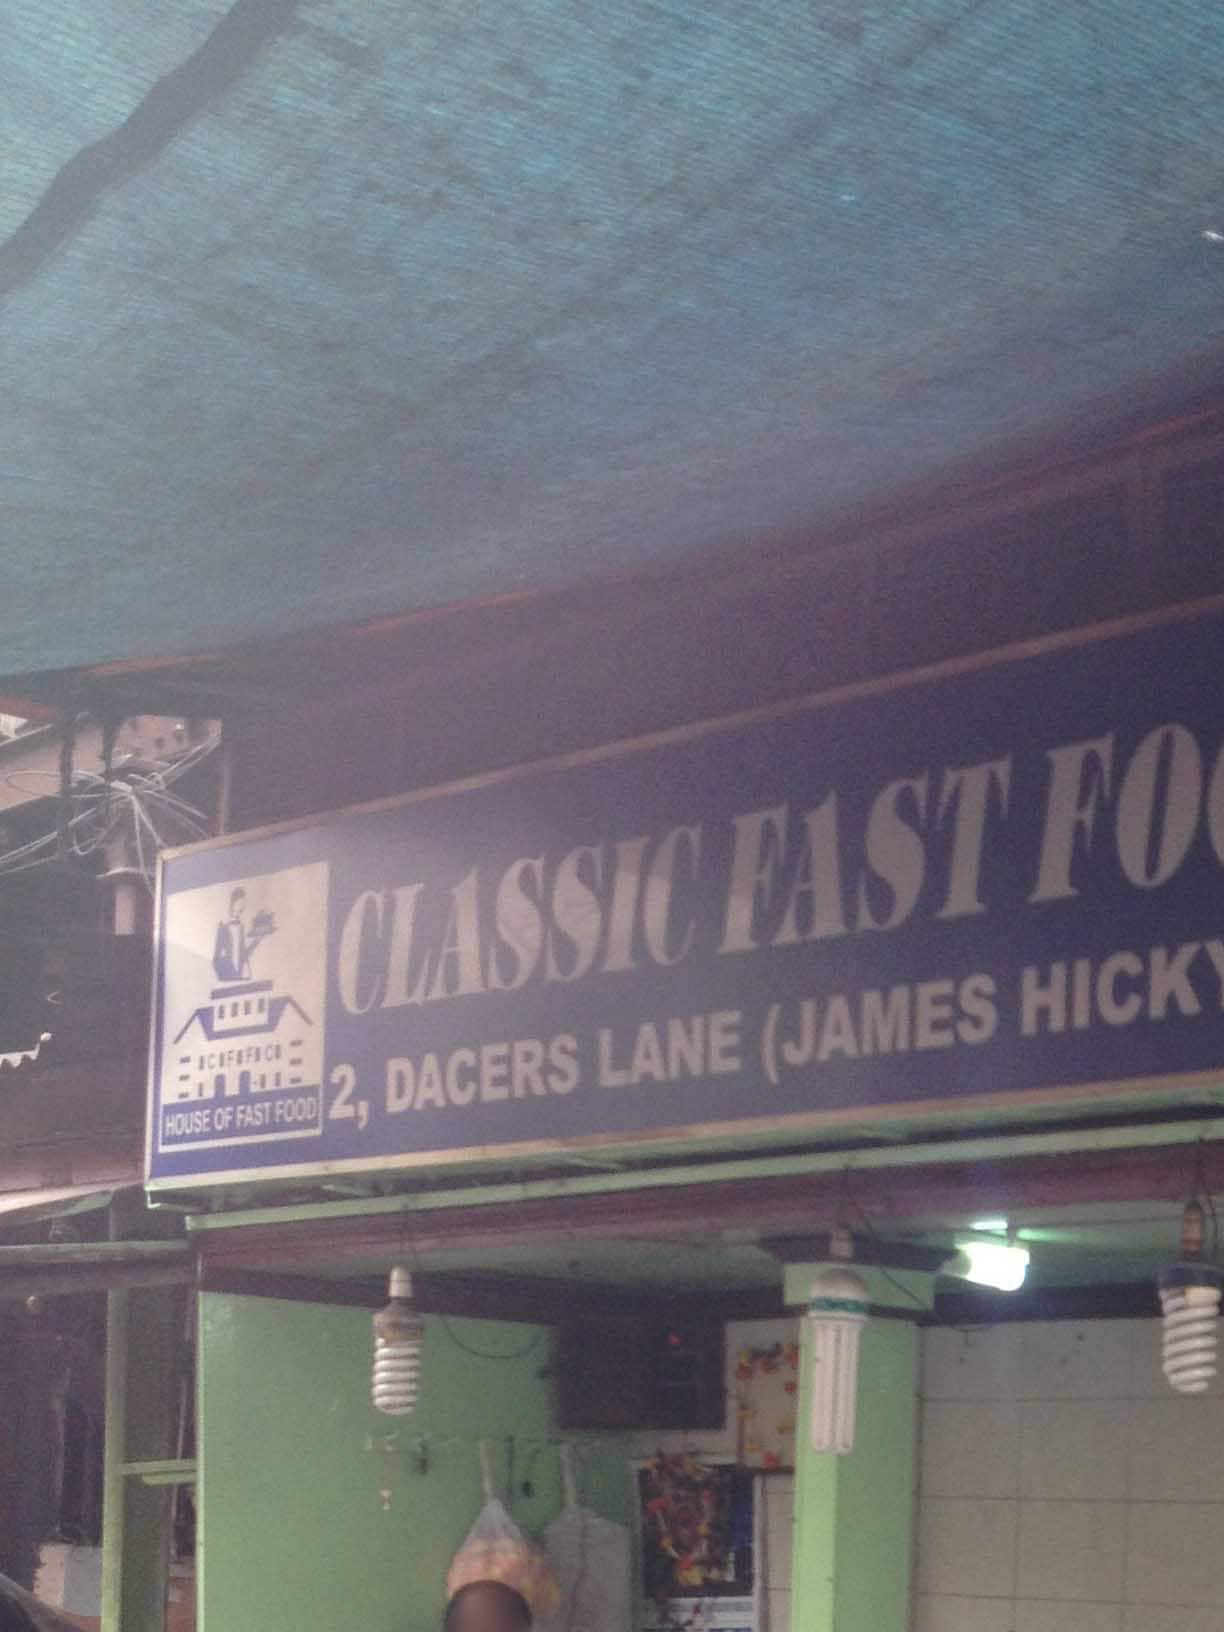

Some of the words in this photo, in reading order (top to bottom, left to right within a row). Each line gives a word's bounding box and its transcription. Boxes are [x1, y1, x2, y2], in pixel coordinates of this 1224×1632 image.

[337, 824, 702, 1015] CLASSIC
[718, 752, 1012, 954] FAST
[164, 1109, 211, 1137] HOUSE
[213, 1106, 234, 1131] OF
[236, 1101, 273, 1129] FAST
[274, 1096, 317, 1124] FOOD
[329, 1064, 369, 1129] 2,
[385, 1034, 580, 1113] DACERS
[598, 1010, 742, 1087] LANE
[761, 973, 998, 1084] (JAMES
